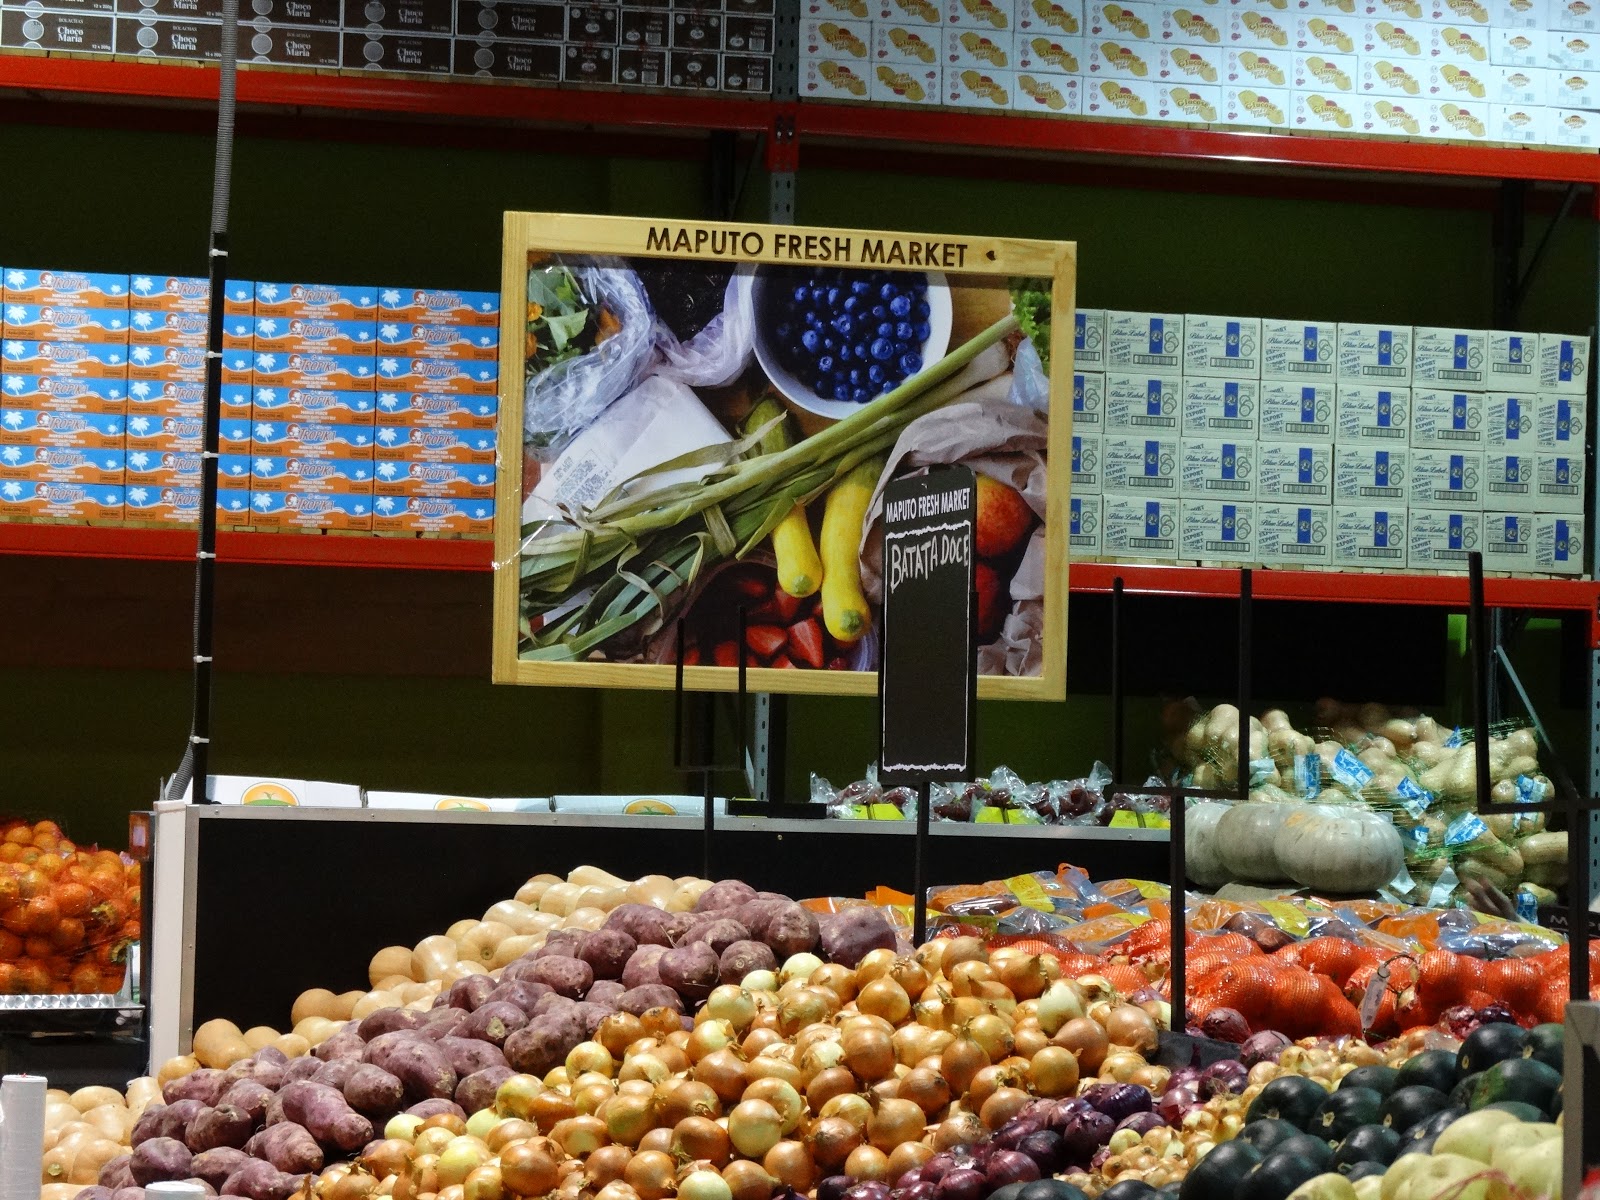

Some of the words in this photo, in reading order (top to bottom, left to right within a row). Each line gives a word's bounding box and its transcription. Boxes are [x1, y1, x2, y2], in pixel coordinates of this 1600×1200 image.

[285, 1, 311, 11] Choco
[1452, 1, 1483, 11] Glucose
[286, 8, 311, 18] Maria
[397, 8, 423, 18] Choco
[398, 15, 423, 25] Maria
[510, 15, 536, 25] Choco
[1110, 14, 1141, 24] Glucose
[1181, 19, 1212, 29] Glucose
[57, 26, 83, 36] Choco
[511, 22, 536, 32] Maria
[1249, 21, 1280, 31] Glucose
[58, 33, 82, 43] Maria
[171, 34, 197, 44] Choco
[1315, 29, 1346, 39] Glucose
[1382, 32, 1413, 42] Glucose
[172, 41, 196, 51] Maria
[285, 40, 311, 50] Choco
[1448, 37, 1479, 47] Glucose
[286, 47, 310, 57] Maria
[396, 47, 422, 57] Choco
[1108, 52, 1139, 62] Glucose
[397, 54, 422, 64] Maria
[506, 55, 532, 65] Choco
[1178, 58, 1209, 68] Glucose
[507, 62, 532, 72] Maria
[1246, 61, 1277, 71] Glucose
[1313, 66, 1344, 76] Glucose
[1381, 70, 1412, 80] Glucose
[1447, 74, 1478, 84] Glucose
[1108, 91, 1139, 101] Glucose
[1178, 97, 1209, 107] Glucose
[1245, 100, 1276, 110] Glucose
[1314, 104, 1345, 114] Glucose
[1381, 110, 1412, 120] Glucose
[1447, 113, 1478, 123] Glucose
[646, 226, 764, 255] MAPUTO
[774, 233, 851, 262] FRESH
[860, 238, 968, 268] MARKET
[52, 277, 90, 290] TROPIKA
[178, 283, 210, 296] TROPIK
[303, 290, 341, 303] TROPIKA
[425, 295, 463, 308] TROPIKA
[53, 312, 90, 325] TROPIKA
[178, 318, 209, 330] TROPIK
[302, 324, 339, 337] TROPIKA
[424, 330, 461, 343] TROPIKA
[51, 347, 88, 360] TROPIKA
[300, 359, 338, 372] TROPIKA
[423, 364, 460, 377] TROPIKA
[51, 382, 88, 395] TROPIKA
[301, 394, 338, 407] TROPIKA
[422, 398, 460, 411] TROPIKA
[50, 417, 87, 430] TROPIKA
[299, 428, 336, 441] TROPIKA
[421, 433, 459, 446] TROPIKA
[48, 452, 85, 465] TROPIKA
[298, 463, 336, 476] TROPIKA
[421, 468, 458, 481] TROPIKA
[48, 488, 86, 501] TROPIKA
[297, 498, 335, 511] TROPIKA
[419, 502, 457, 515] TROPIKA
[885, 498, 917, 524] MAPUTO
[918, 493, 940, 518] FRESH
[941, 487, 971, 514] MARKET
[890, 535, 938, 594] BATATA
[940, 534, 969, 567] DOCE
